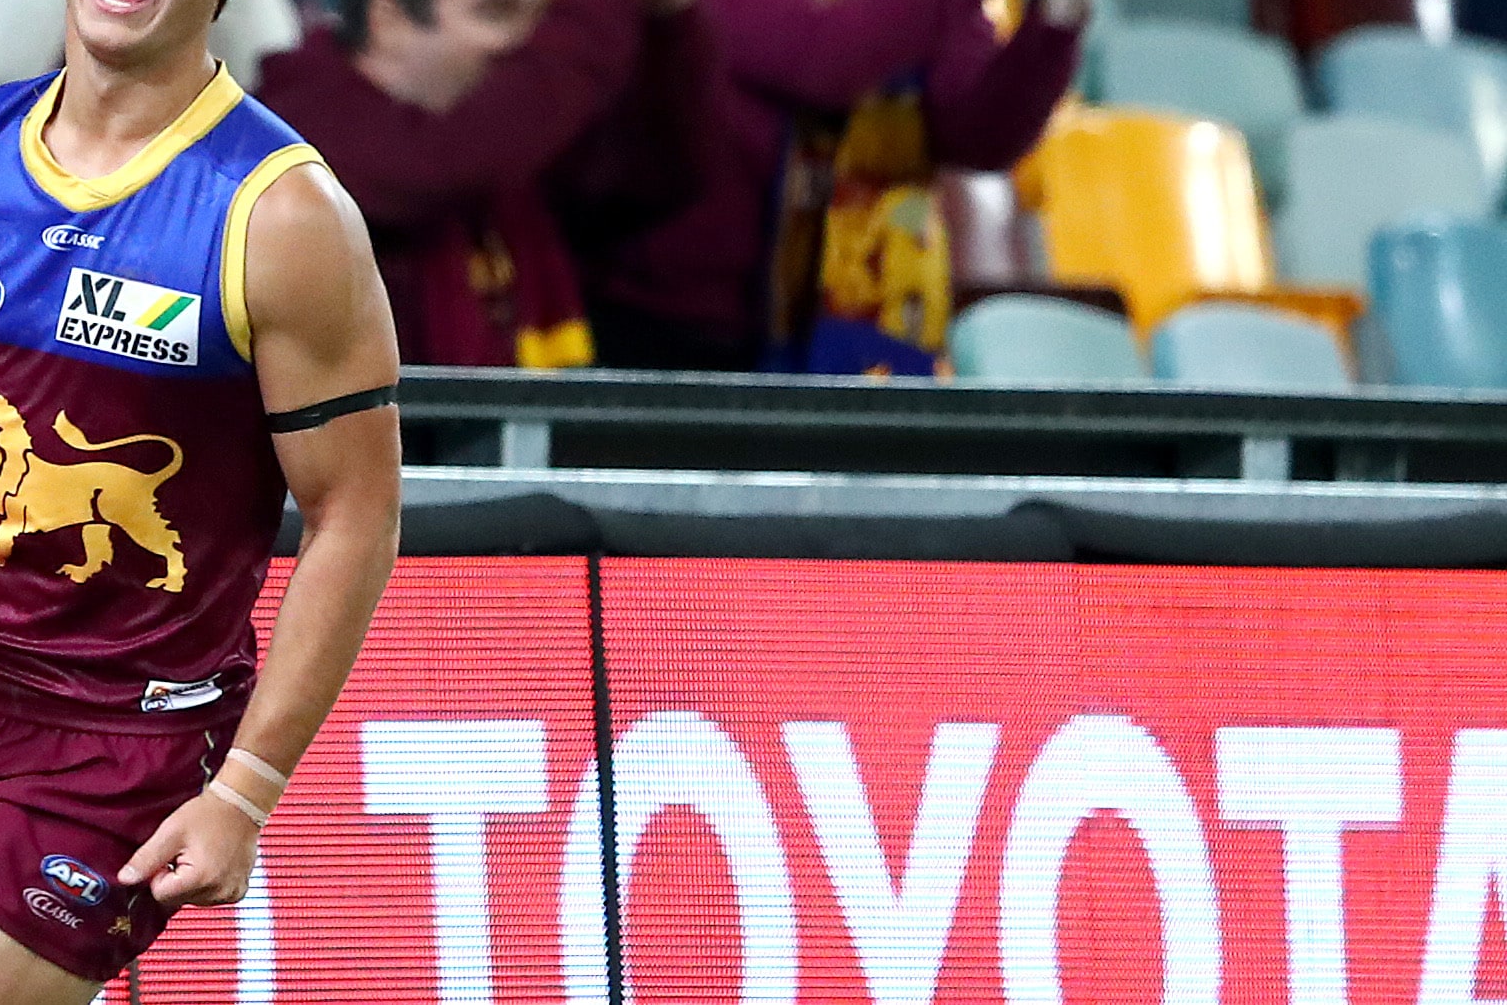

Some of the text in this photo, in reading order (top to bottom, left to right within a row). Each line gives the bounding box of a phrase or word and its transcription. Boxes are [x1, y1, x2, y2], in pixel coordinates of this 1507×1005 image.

[68, 273, 127, 322] XL
[59, 317, 190, 363] EXPRESS
[45, 863, 100, 903] AFL
